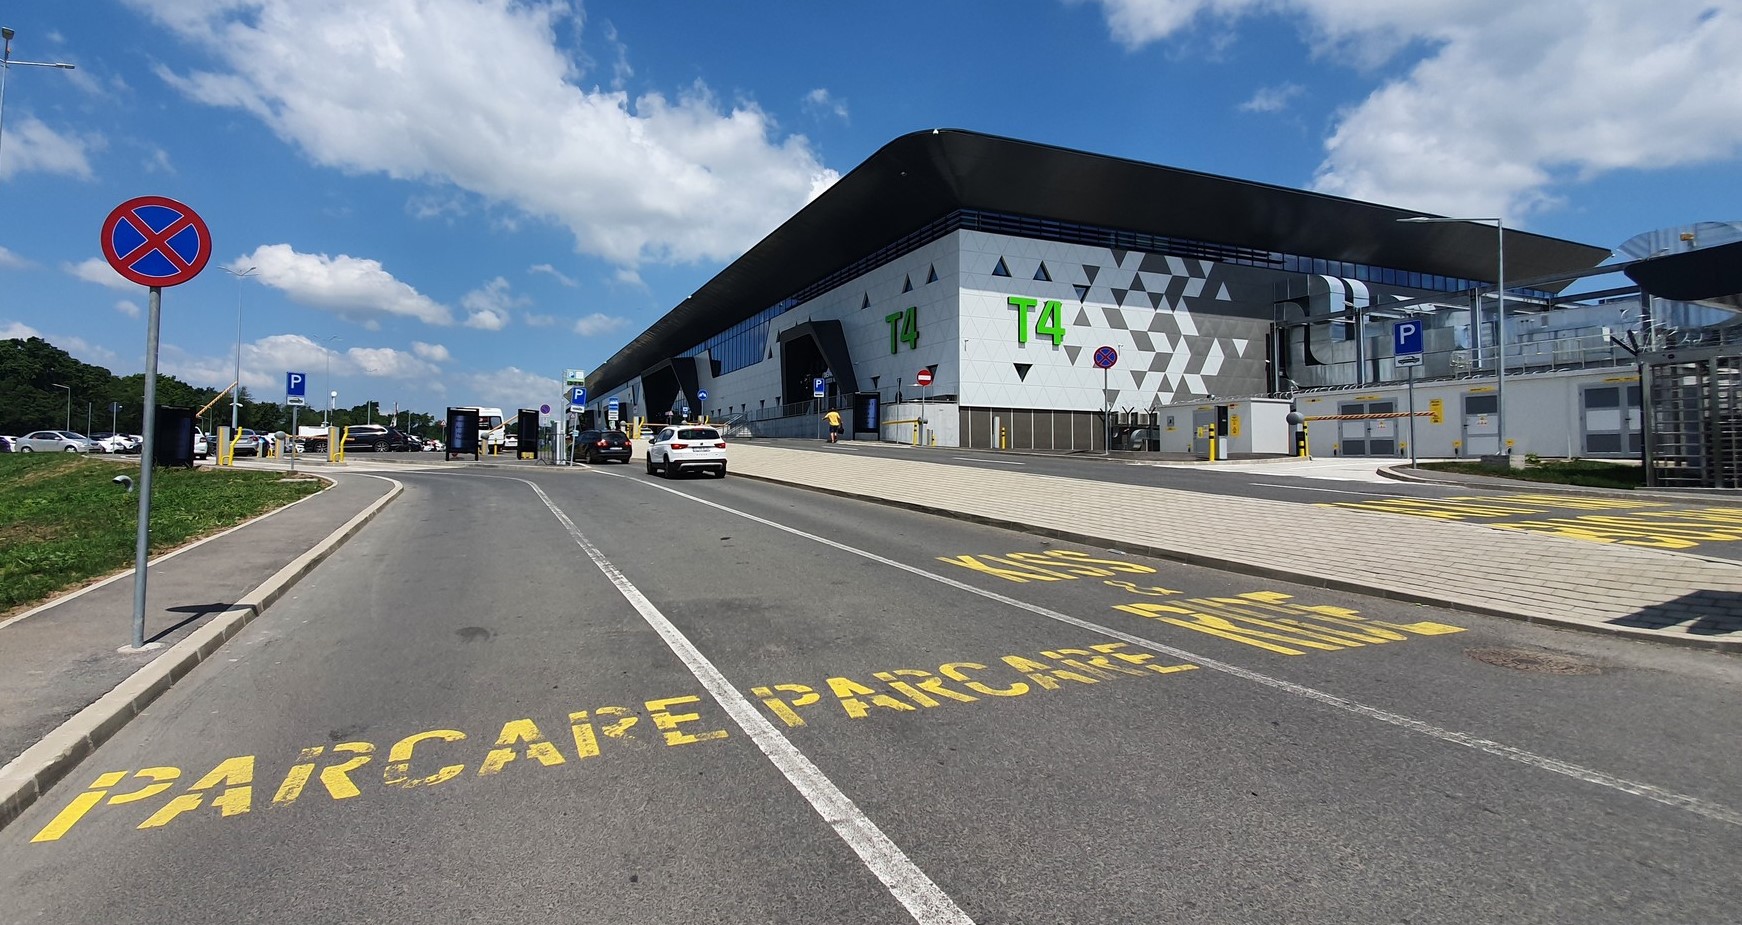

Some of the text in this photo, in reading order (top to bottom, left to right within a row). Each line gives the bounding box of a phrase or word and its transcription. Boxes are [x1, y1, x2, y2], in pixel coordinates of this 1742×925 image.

[885, 306, 920, 355] T4
[1007, 296, 1066, 346] T4
[1400, 324, 1416, 345] P
[290, 374, 302, 389] P
[574, 388, 584, 400] P
[815, 379, 822, 388] P
[935, 550, 1158, 583] KISS
[1103, 579, 1185, 595] &
[1111, 590, 1468, 656] RIDE
[29, 642, 1200, 844] PARCARE PARCARE
